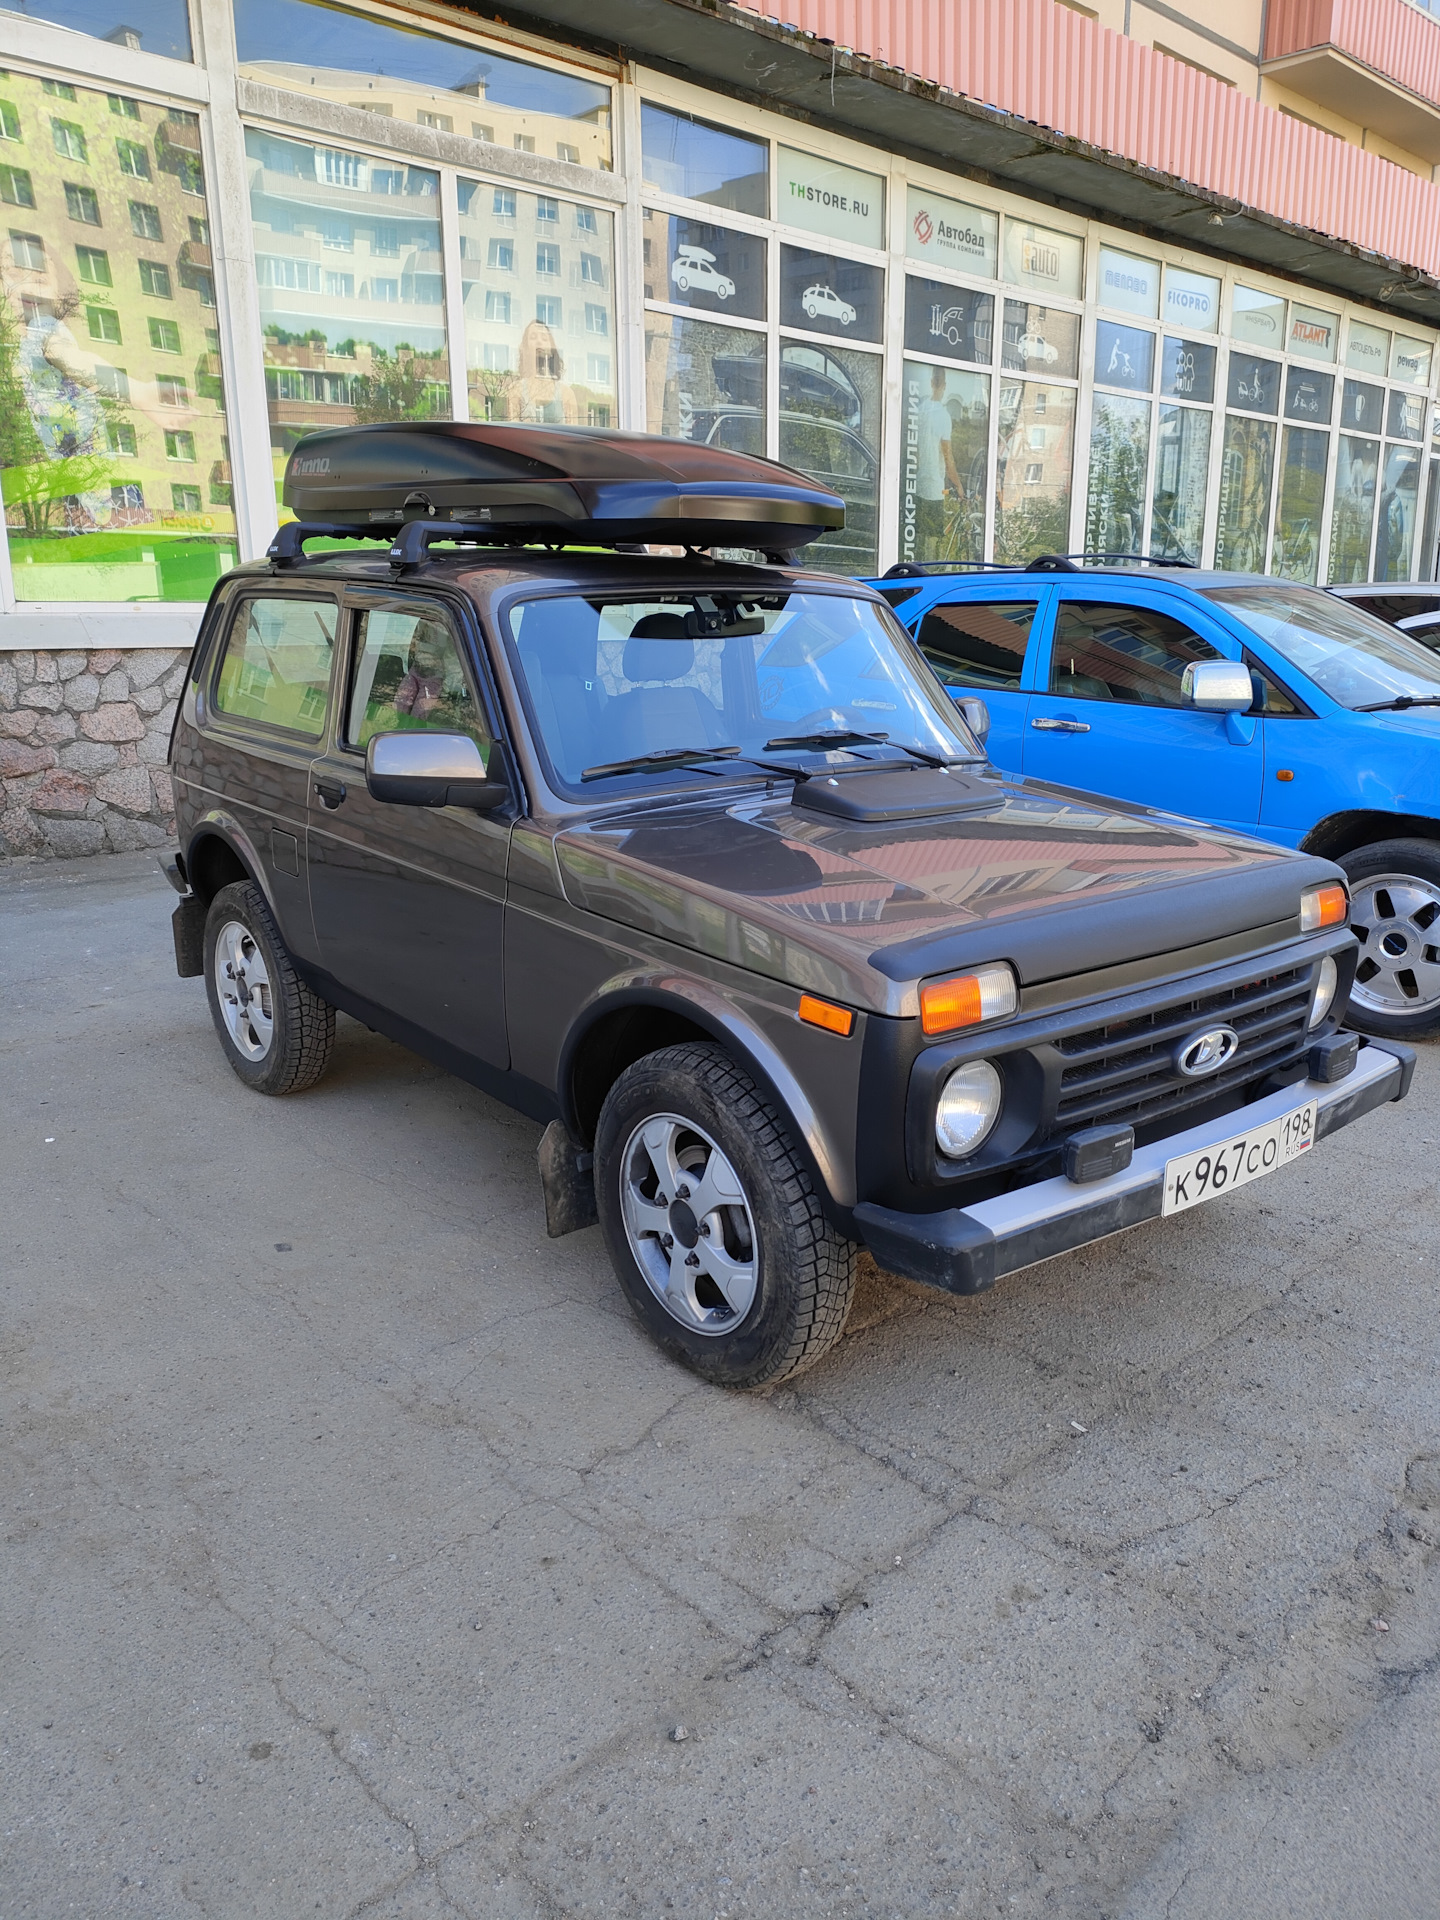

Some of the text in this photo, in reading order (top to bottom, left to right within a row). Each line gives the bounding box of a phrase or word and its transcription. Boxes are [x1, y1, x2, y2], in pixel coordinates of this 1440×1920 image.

[789, 181, 869, 217] THSTORE.RU
[937, 239, 957, 250] ГРУППА
[938, 220, 985, 248] Автобад
[1167, 290, 1209, 313] FICOPRO
[1292, 322, 1327, 344] ATLANT
[1350, 341, 1382, 357] АВТОЦЕПЬ.РФ
[1397, 355, 1419, 371] pewag
[1283, 1108, 1311, 1146] 198
[1285, 1141, 1301, 1158] RUS
[1174, 1137, 1277, 1205] К967СО
